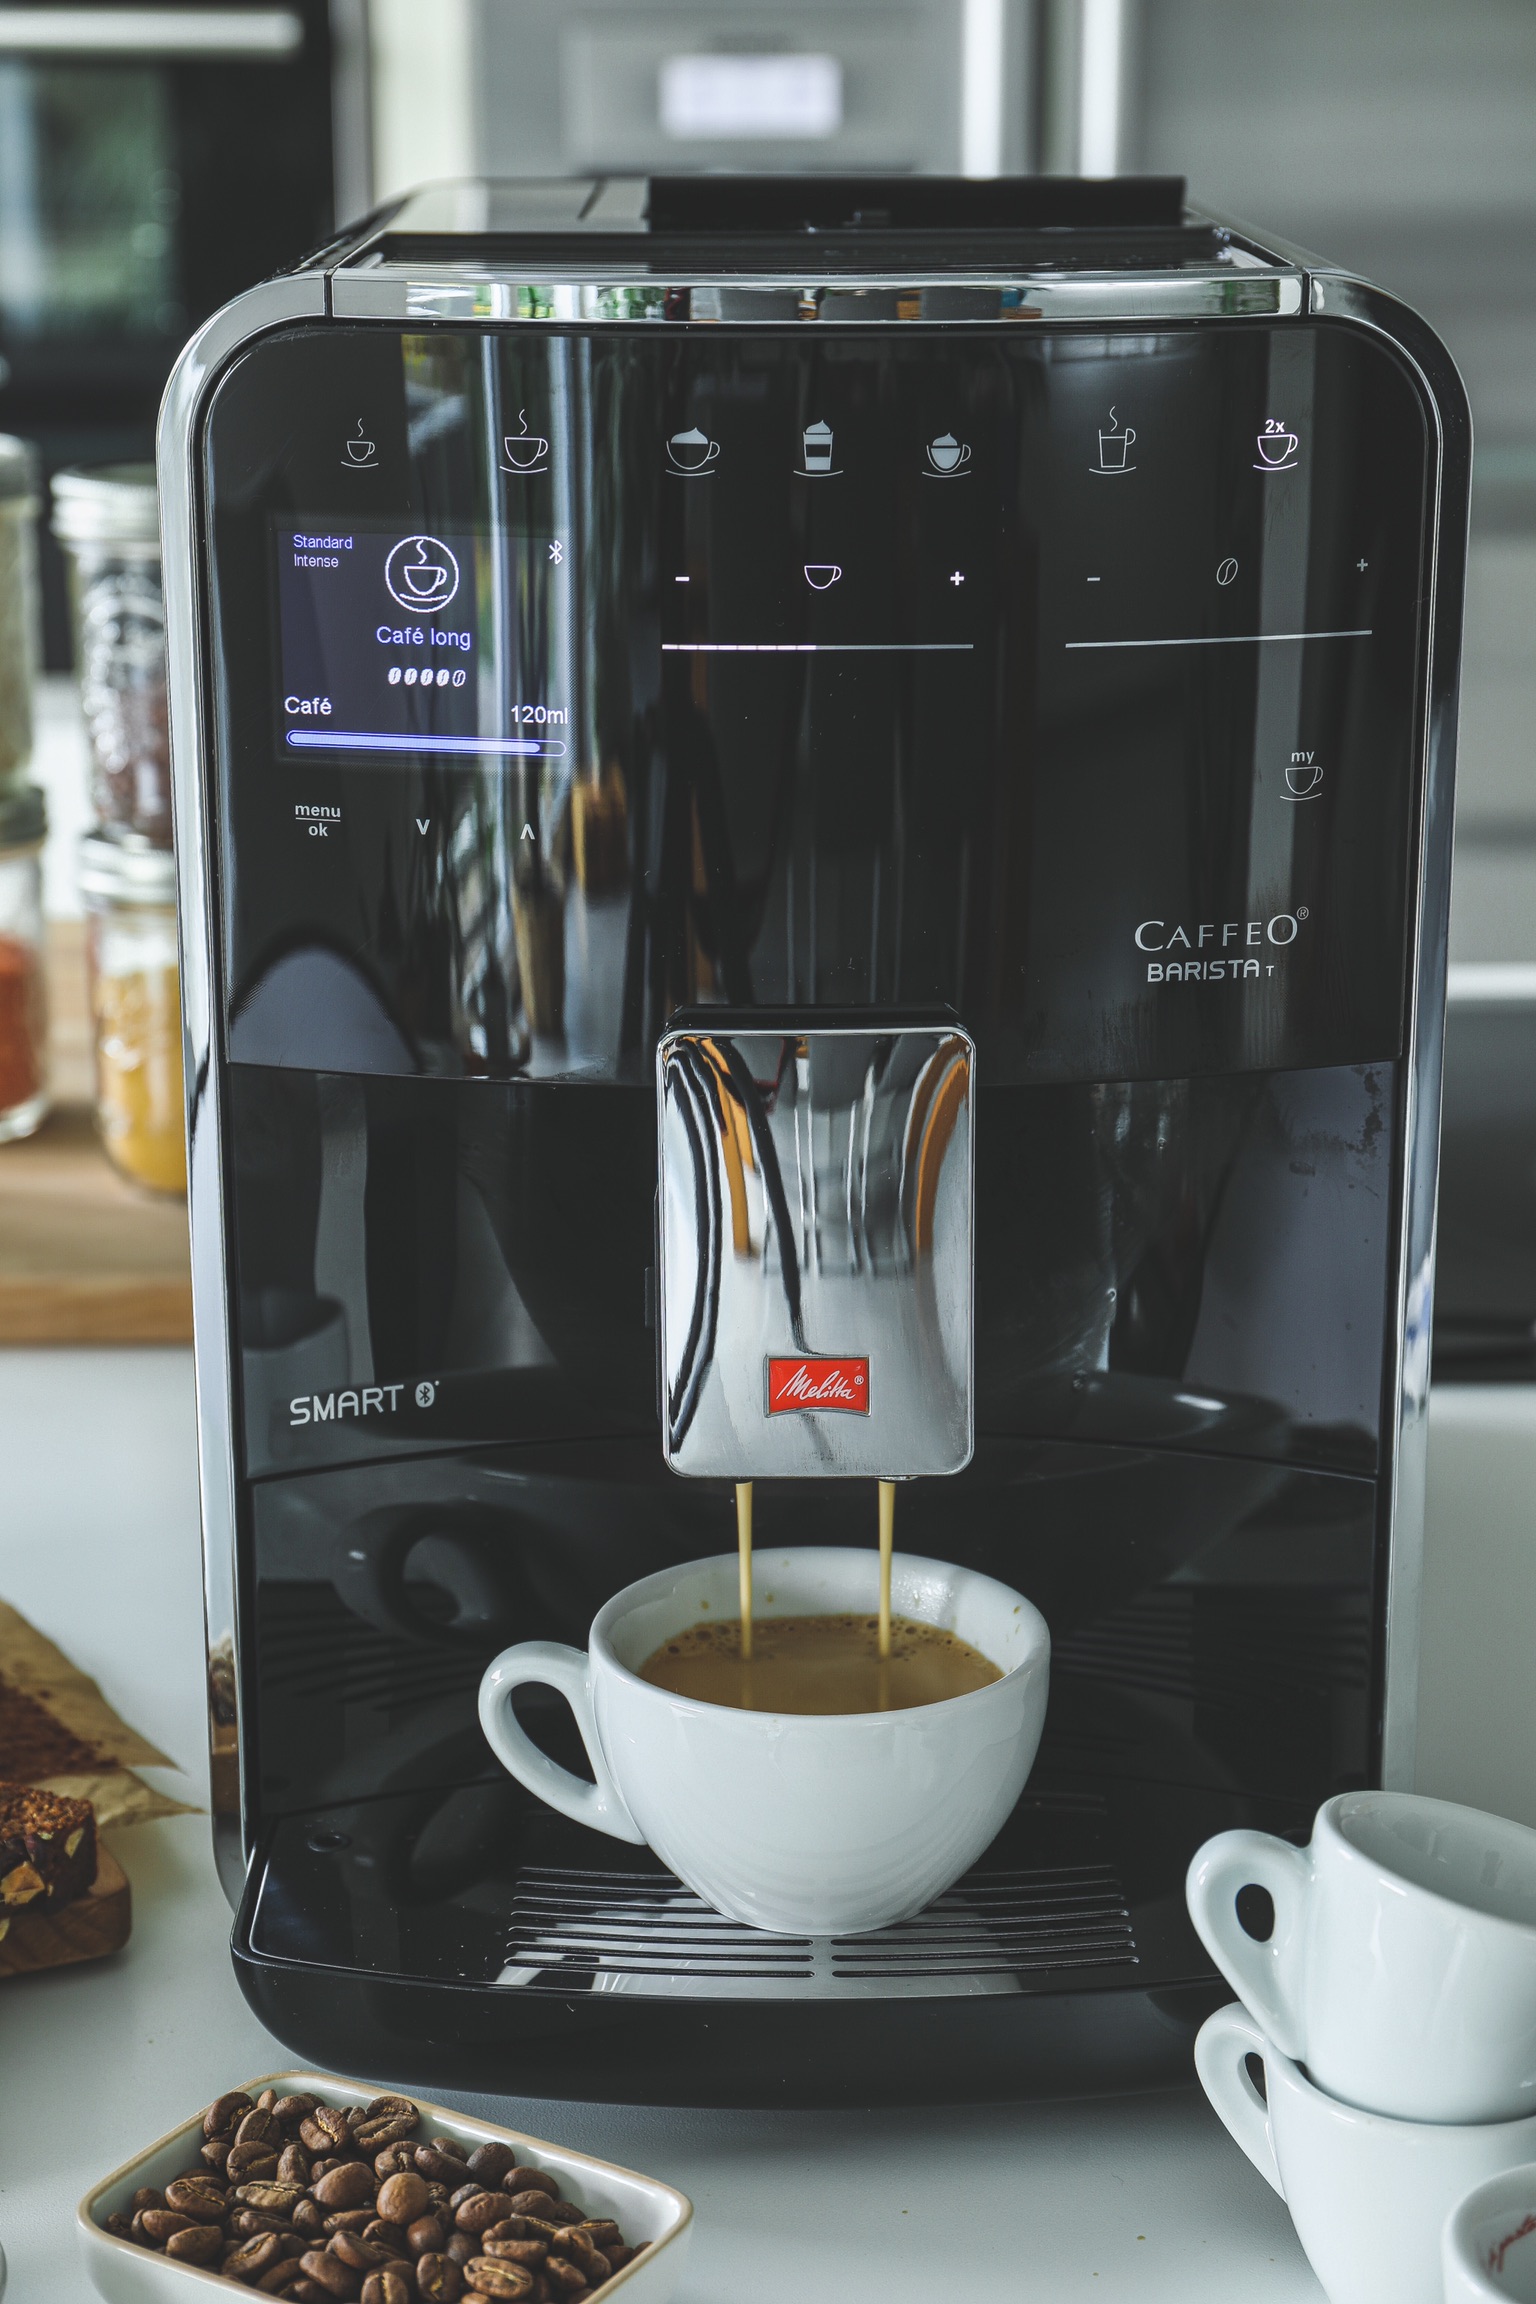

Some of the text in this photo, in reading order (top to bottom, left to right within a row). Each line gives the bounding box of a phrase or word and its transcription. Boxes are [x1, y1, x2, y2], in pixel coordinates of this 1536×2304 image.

[1265, 418, 1285, 433] 2x
[293, 534, 353, 549] Standard
[293, 553, 339, 568] Intense
[376, 626, 471, 651] Café long
[284, 696, 569, 725] Café 120ml
[1291, 750, 1315, 765] my
[295, 804, 341, 818] menu
[308, 822, 328, 837] ok
[1147, 958, 1275, 983] BARISTA T
[289, 1383, 405, 1426] SMART
